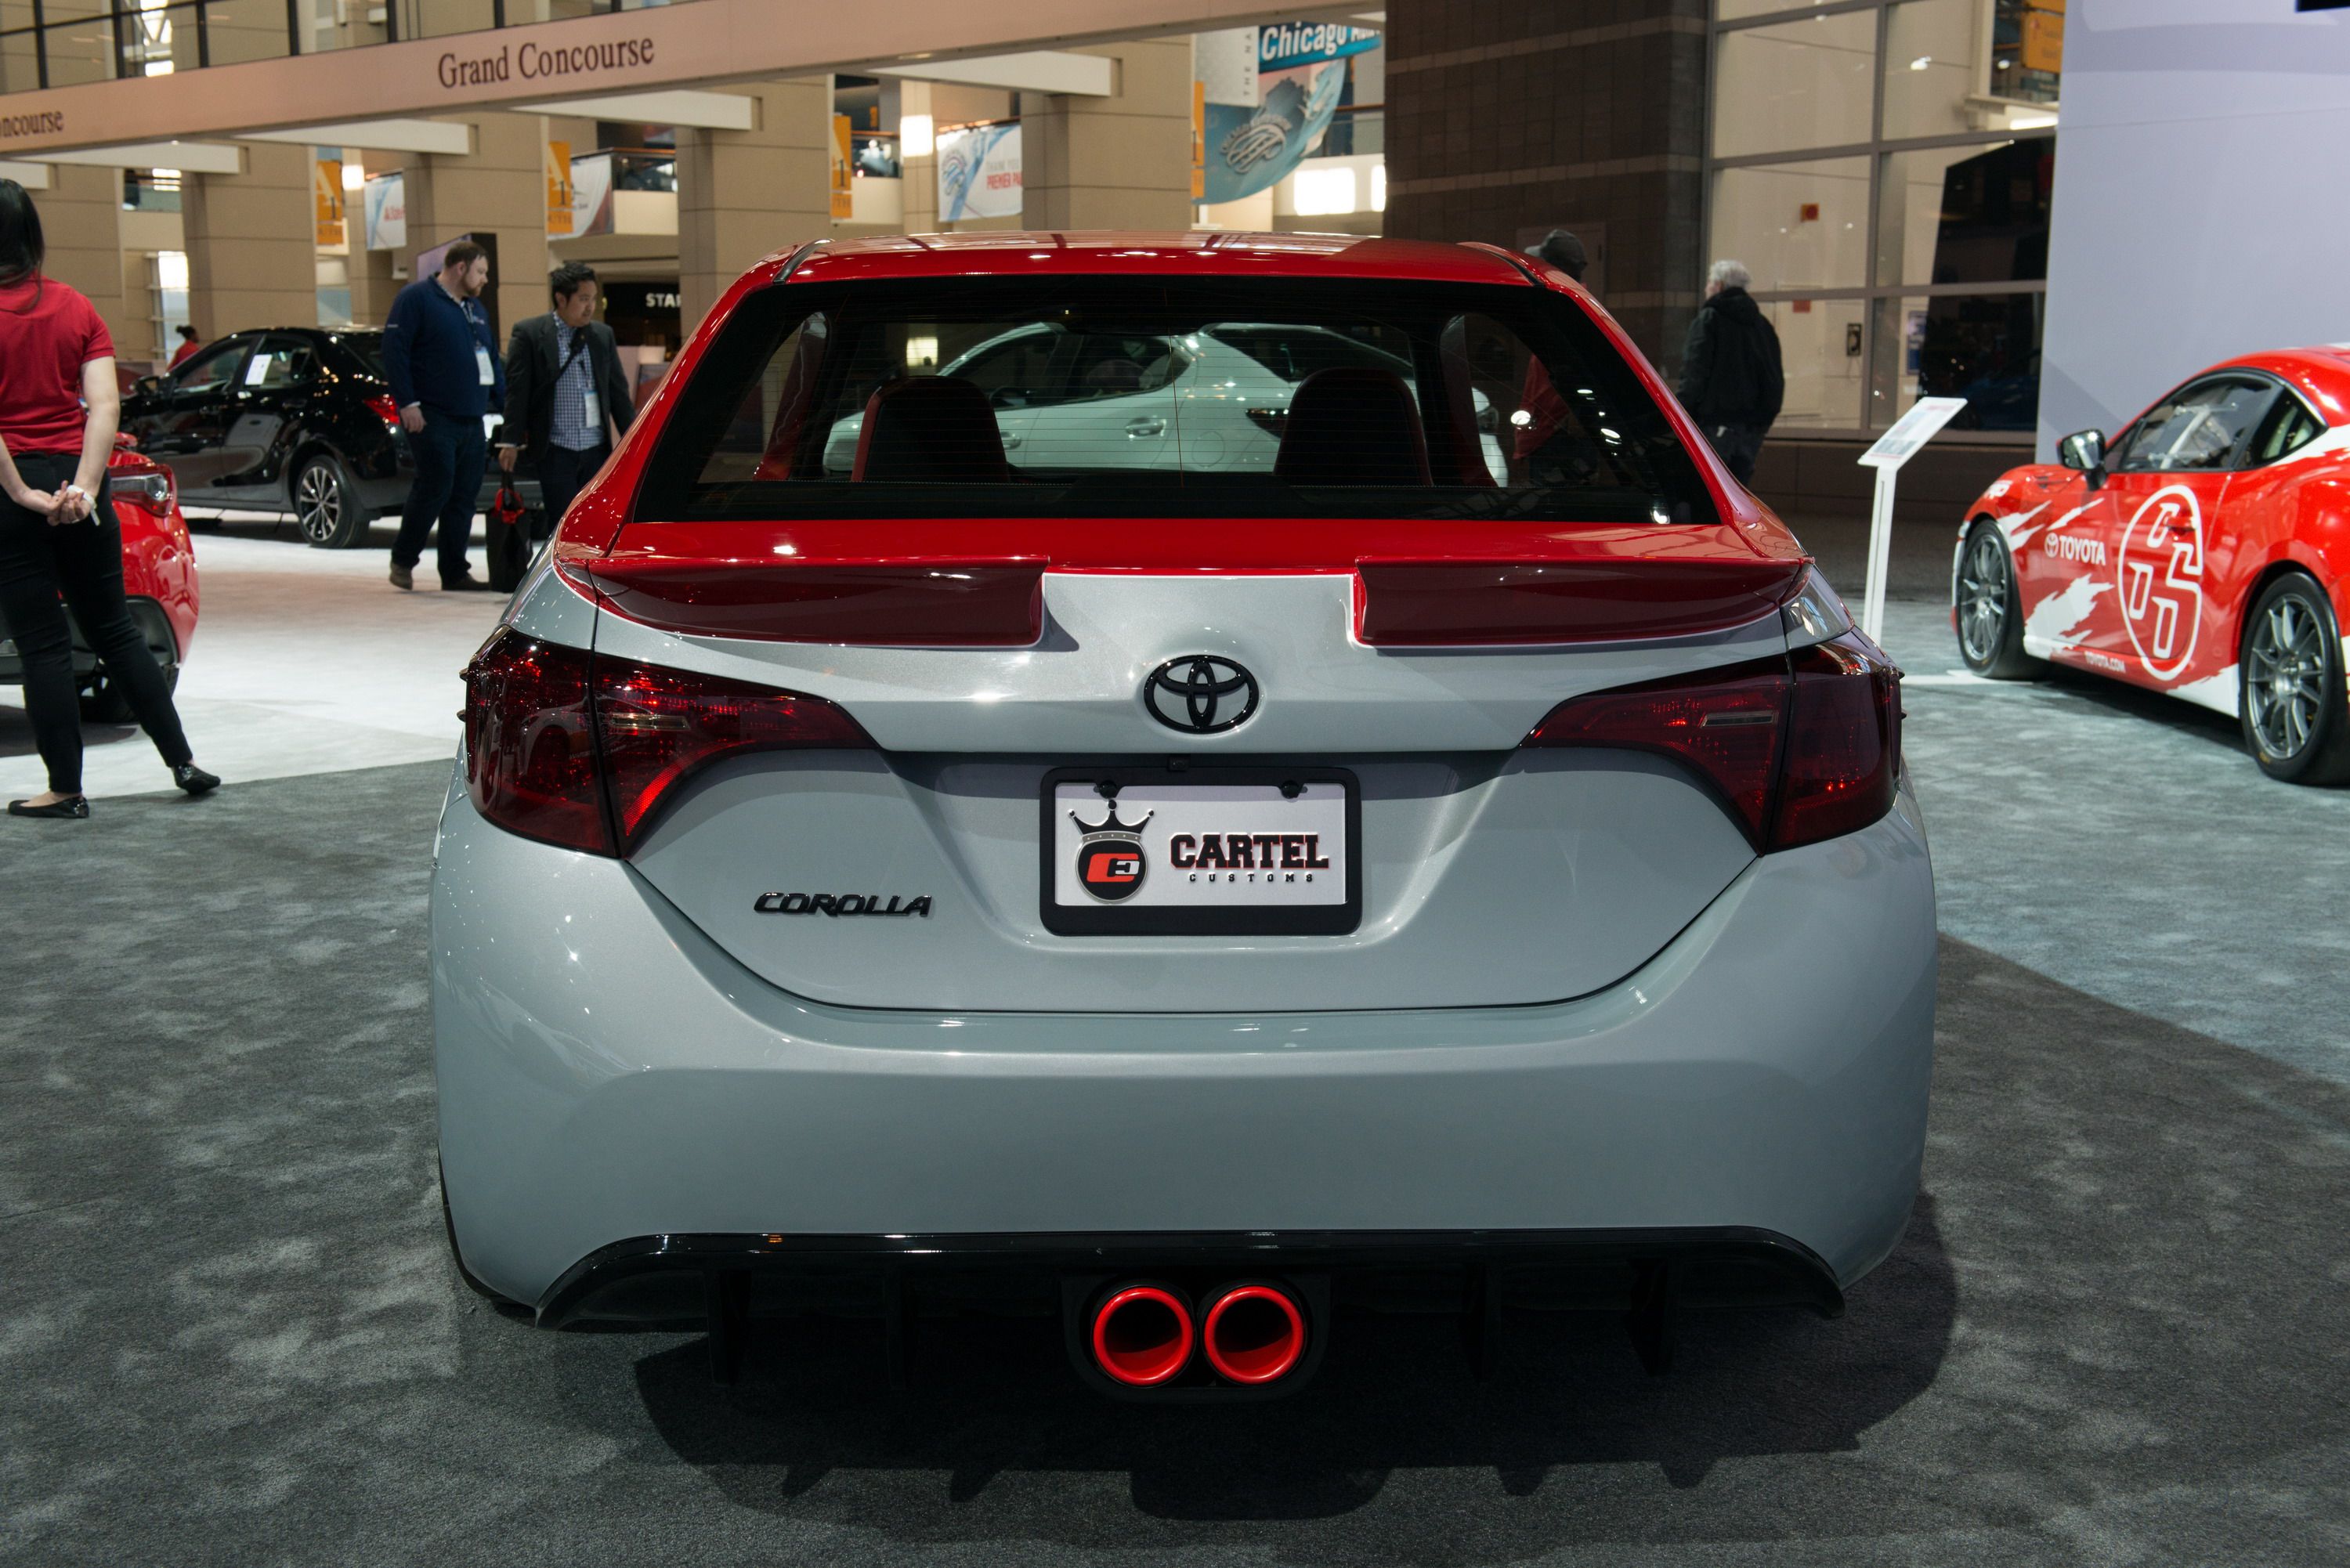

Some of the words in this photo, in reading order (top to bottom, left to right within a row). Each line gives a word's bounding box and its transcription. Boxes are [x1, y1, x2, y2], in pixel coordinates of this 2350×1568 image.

[1261, 21, 1348, 61] Chicago
[438, 45, 510, 89] Grand
[518, 38, 655, 80] Concourse
[0, 110, 64, 139] ncourse
[2059, 535, 2106, 566] TOYOTA
[1170, 832, 1330, 870] CARTEL
[1188, 873, 1314, 883] CUSTOMS
[753, 892, 933, 917] COROLLA
